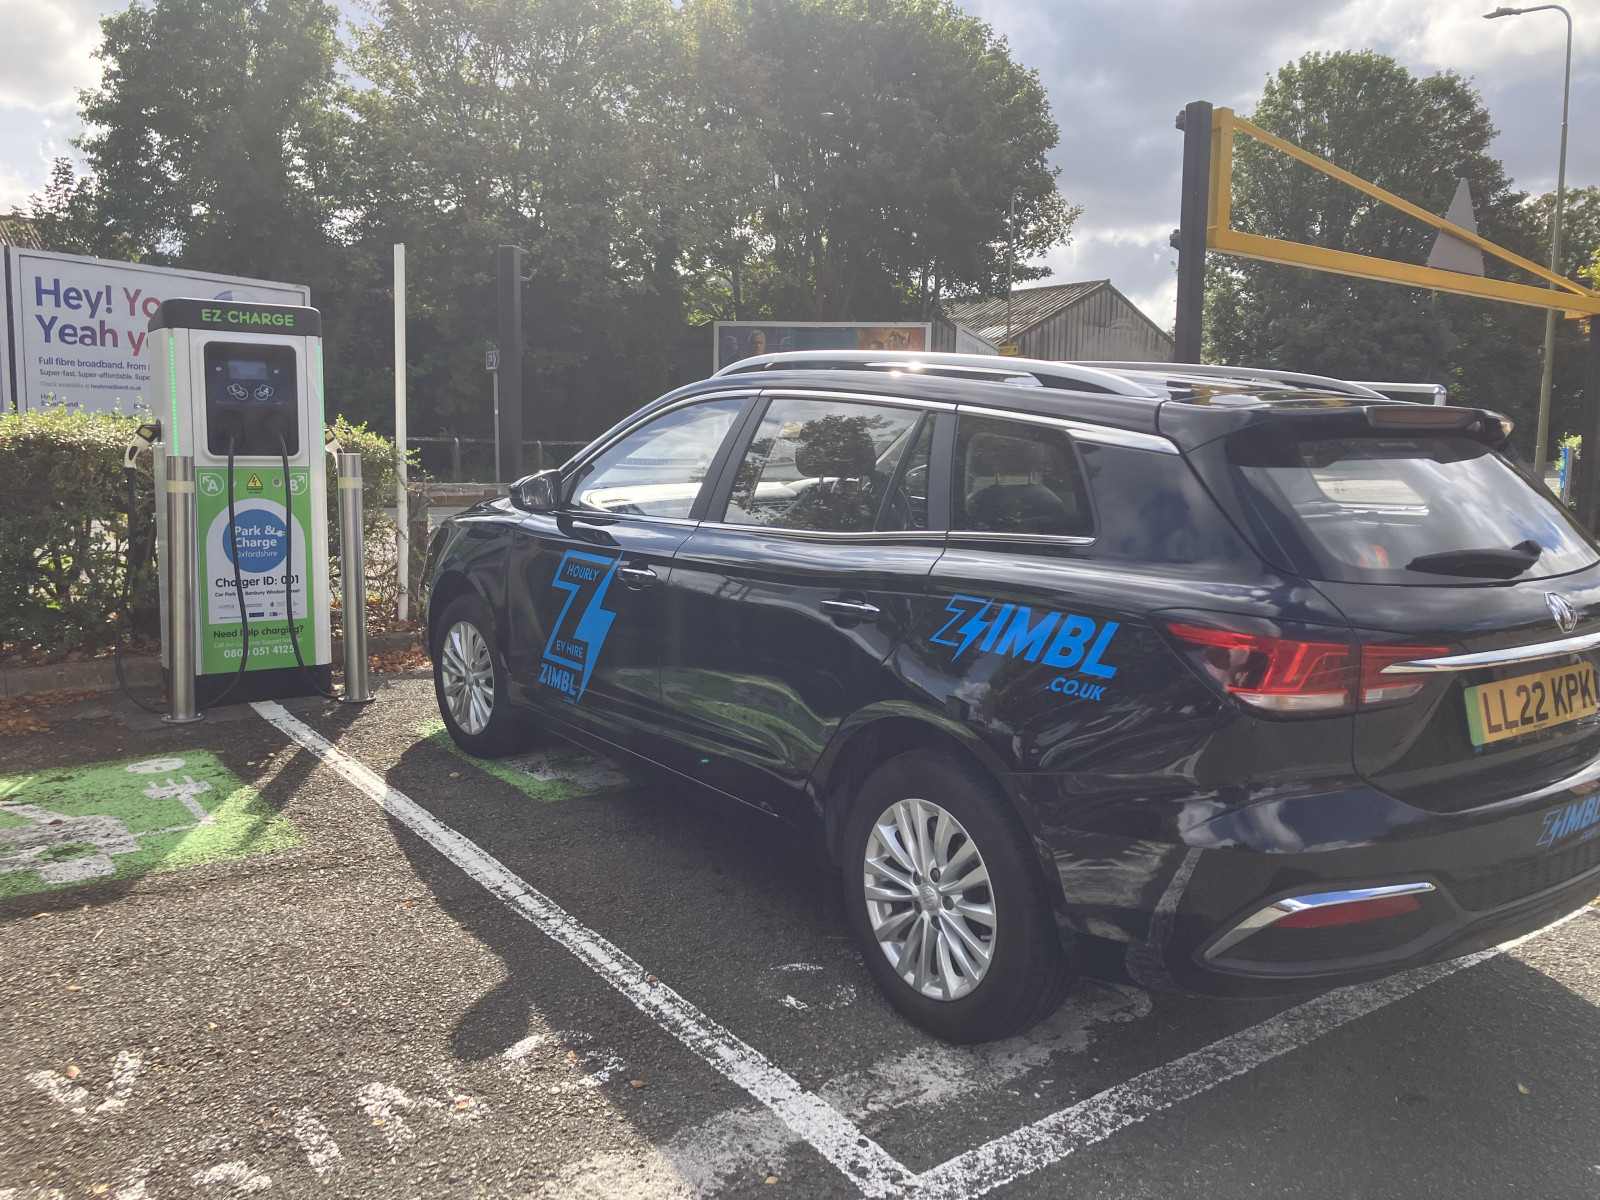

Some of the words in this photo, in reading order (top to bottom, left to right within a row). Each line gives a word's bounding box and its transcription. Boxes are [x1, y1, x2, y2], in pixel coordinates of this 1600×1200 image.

[35, 276, 112, 319] Hey!
[122, 287, 163, 318] Yo
[35, 314, 118, 348] Yeah
[39, 357, 54, 365] Full
[55, 357, 76, 367] fibre
[77, 359, 125, 370] broadband.
[126, 362, 147, 371] From
[207, 480, 219, 492] A
[290, 480, 299, 491] B
[234, 525, 261, 536] Park
[235, 537, 278, 550] Charge
[566, 563, 600, 582] HOURLY
[215, 578, 260, 589] Chager
[263, 576, 278, 586] ID:
[213, 629, 238, 638] Need
[261, 625, 304, 636] chargig?
[929, 594, 1120, 679] ZIMBL
[252, 646, 270, 656] 051
[272, 644, 294, 655] 4125
[566, 643, 584, 659] HIRE
[538, 662, 577, 696] ZIMBL
[1045, 677, 1107, 701] .CO.UK
[1482, 681, 1550, 735] LL22
[1550, 669, 1595, 717] KPK
